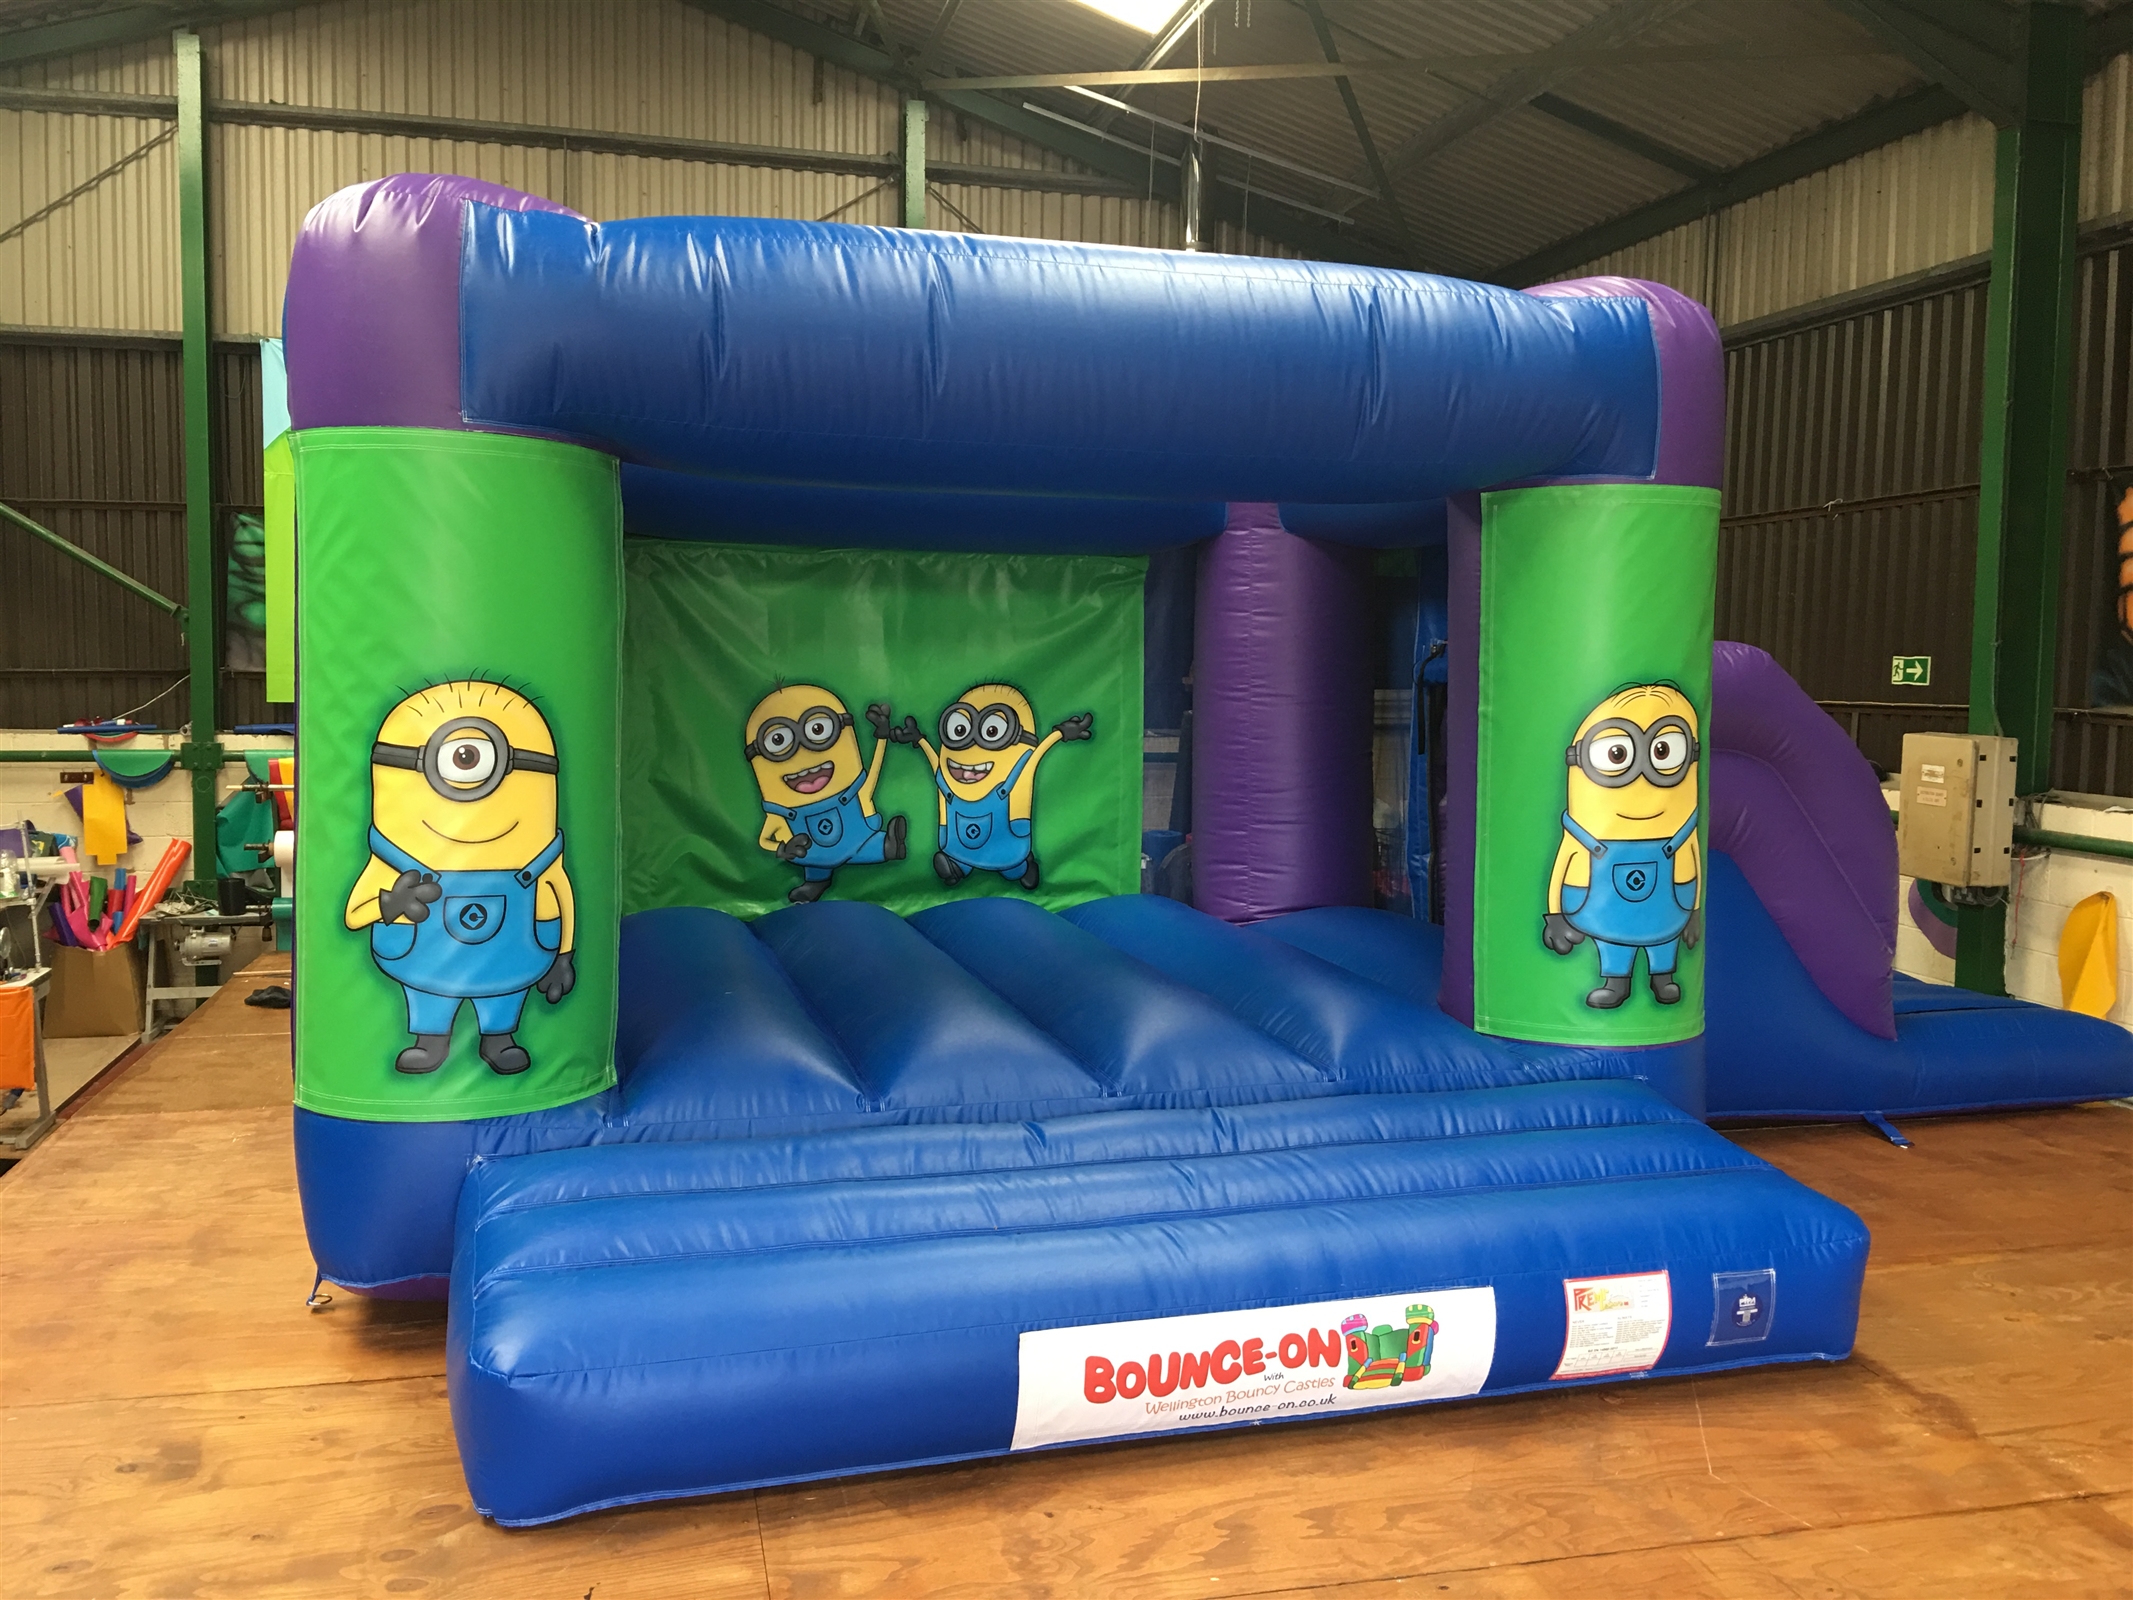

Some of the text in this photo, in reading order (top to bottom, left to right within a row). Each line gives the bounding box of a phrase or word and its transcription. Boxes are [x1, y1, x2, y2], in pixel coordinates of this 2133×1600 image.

[1084, 1327, 1341, 1404] BOUNCE-ON
[1145, 1377, 1336, 1415] Wellington Bouncy Castles
[1179, 1393, 1337, 1421] www.bounce-on.co.uk
